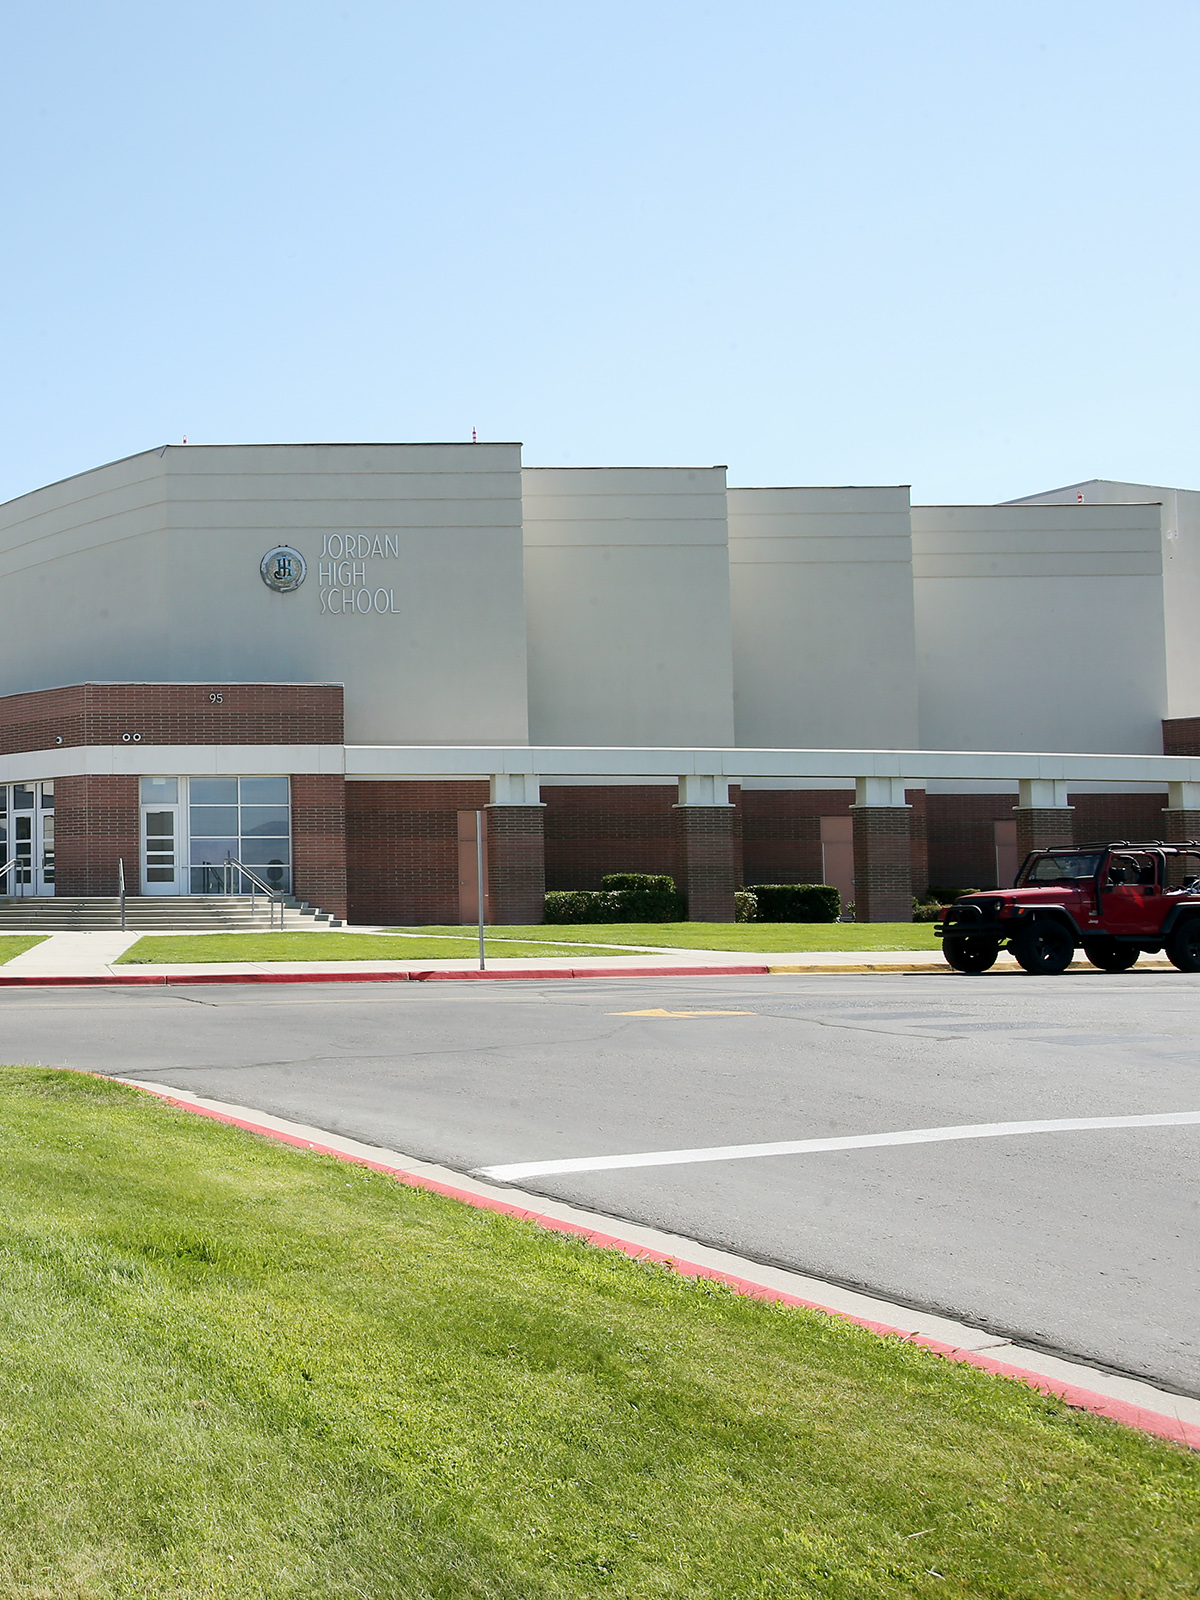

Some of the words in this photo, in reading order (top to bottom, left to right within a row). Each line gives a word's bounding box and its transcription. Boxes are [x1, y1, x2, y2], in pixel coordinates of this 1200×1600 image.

[319, 533, 399, 559] JORDAN
[319, 561, 366, 586] HIGH
[320, 588, 400, 614] SCHOOL
[209, 693, 224, 704] 95
